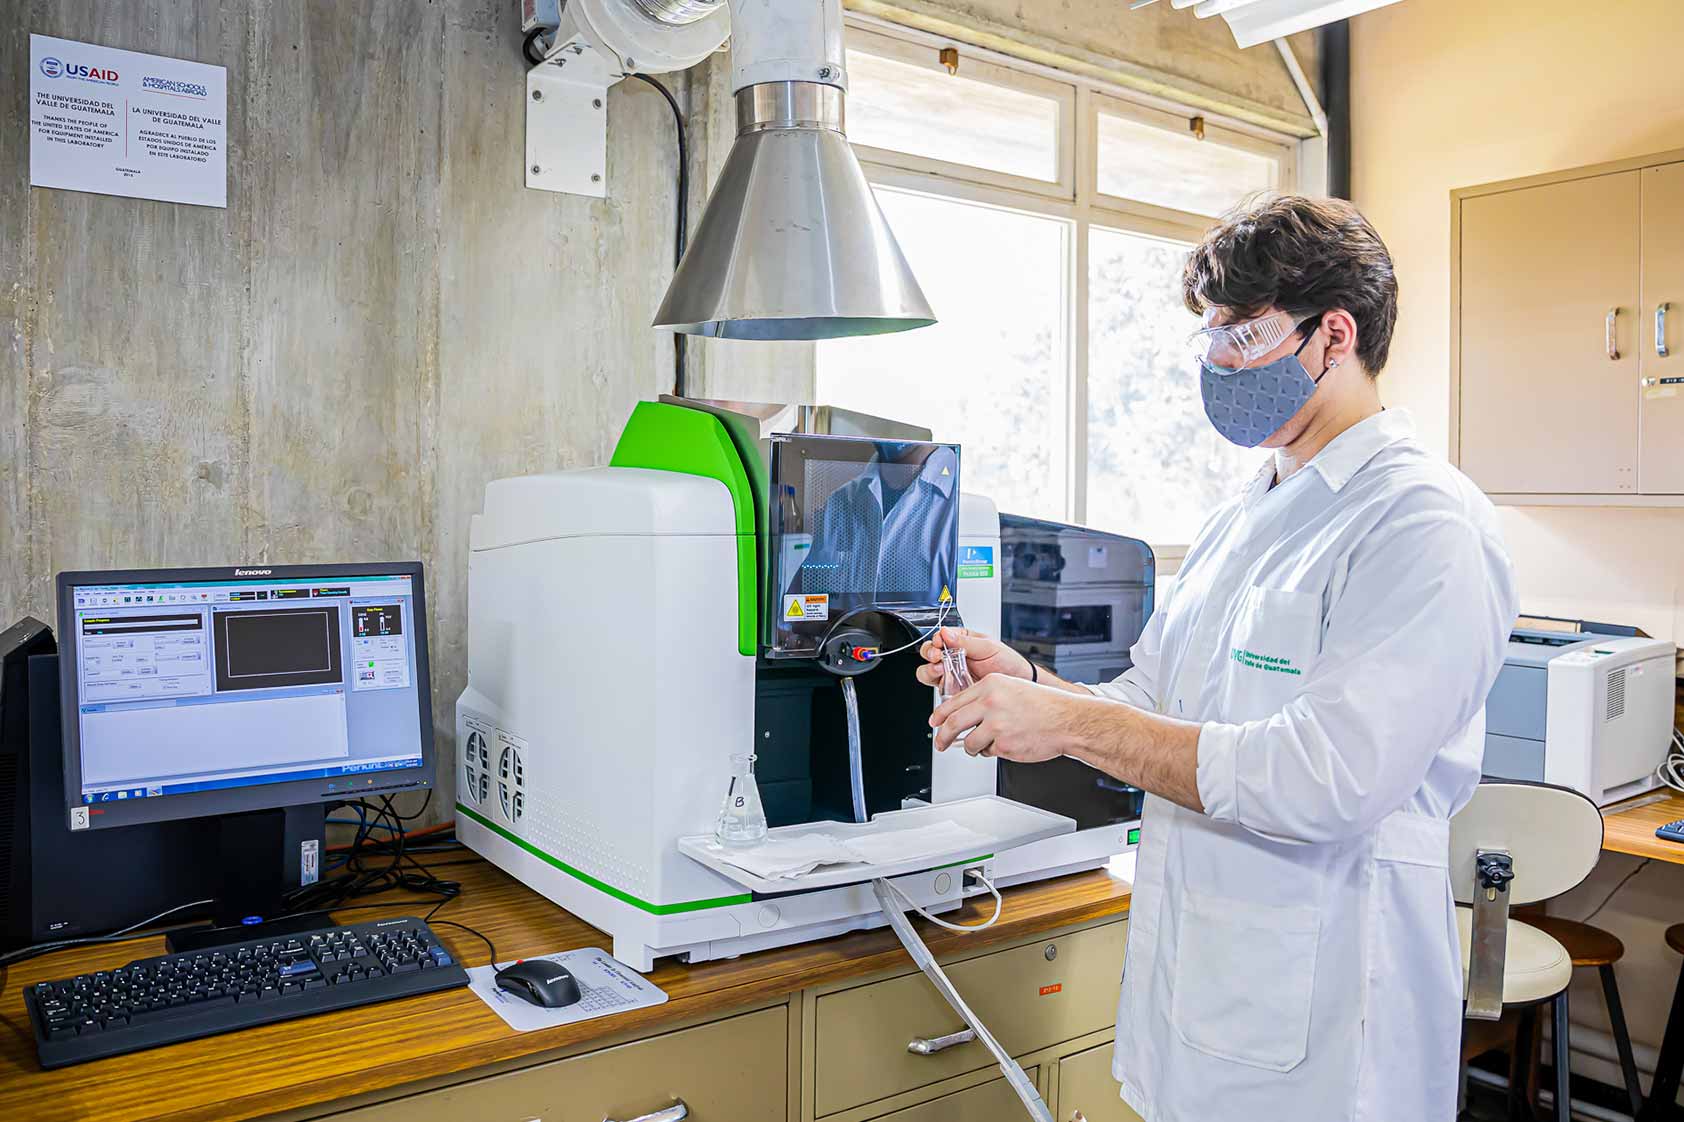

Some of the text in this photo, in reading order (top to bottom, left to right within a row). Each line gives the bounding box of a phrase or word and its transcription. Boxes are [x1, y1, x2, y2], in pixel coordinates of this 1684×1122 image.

[66, 64, 118, 81] USAID
[143, 76, 206, 90] AMERICAN SCHOOLS
[149, 82, 181, 92] HOSPITALS
[182, 87, 207, 96] ABROAD
[52, 94, 100, 106] UNIVERSIDAD
[36, 99, 57, 107] VALLE
[71, 104, 115, 116] GUATEMALA
[143, 109, 187, 120] UNIVERSIDAD
[163, 118, 204, 129] GUATEMALA
[52, 130, 83, 138] EQUIPMENT
[85, 134, 112, 143] INSTALLED
[93, 128, 119, 137] AMERICA
[140, 130, 169, 138] AGRADECE
[67, 139, 104, 148] LABORATORY
[180, 148, 209, 157] INSTALADO
[170, 154, 206, 163] LABORATORIO
[1264, 664, 1301, 675] Guatemala
[735, 797, 744, 807] B
[76, 811, 85, 825] 3
